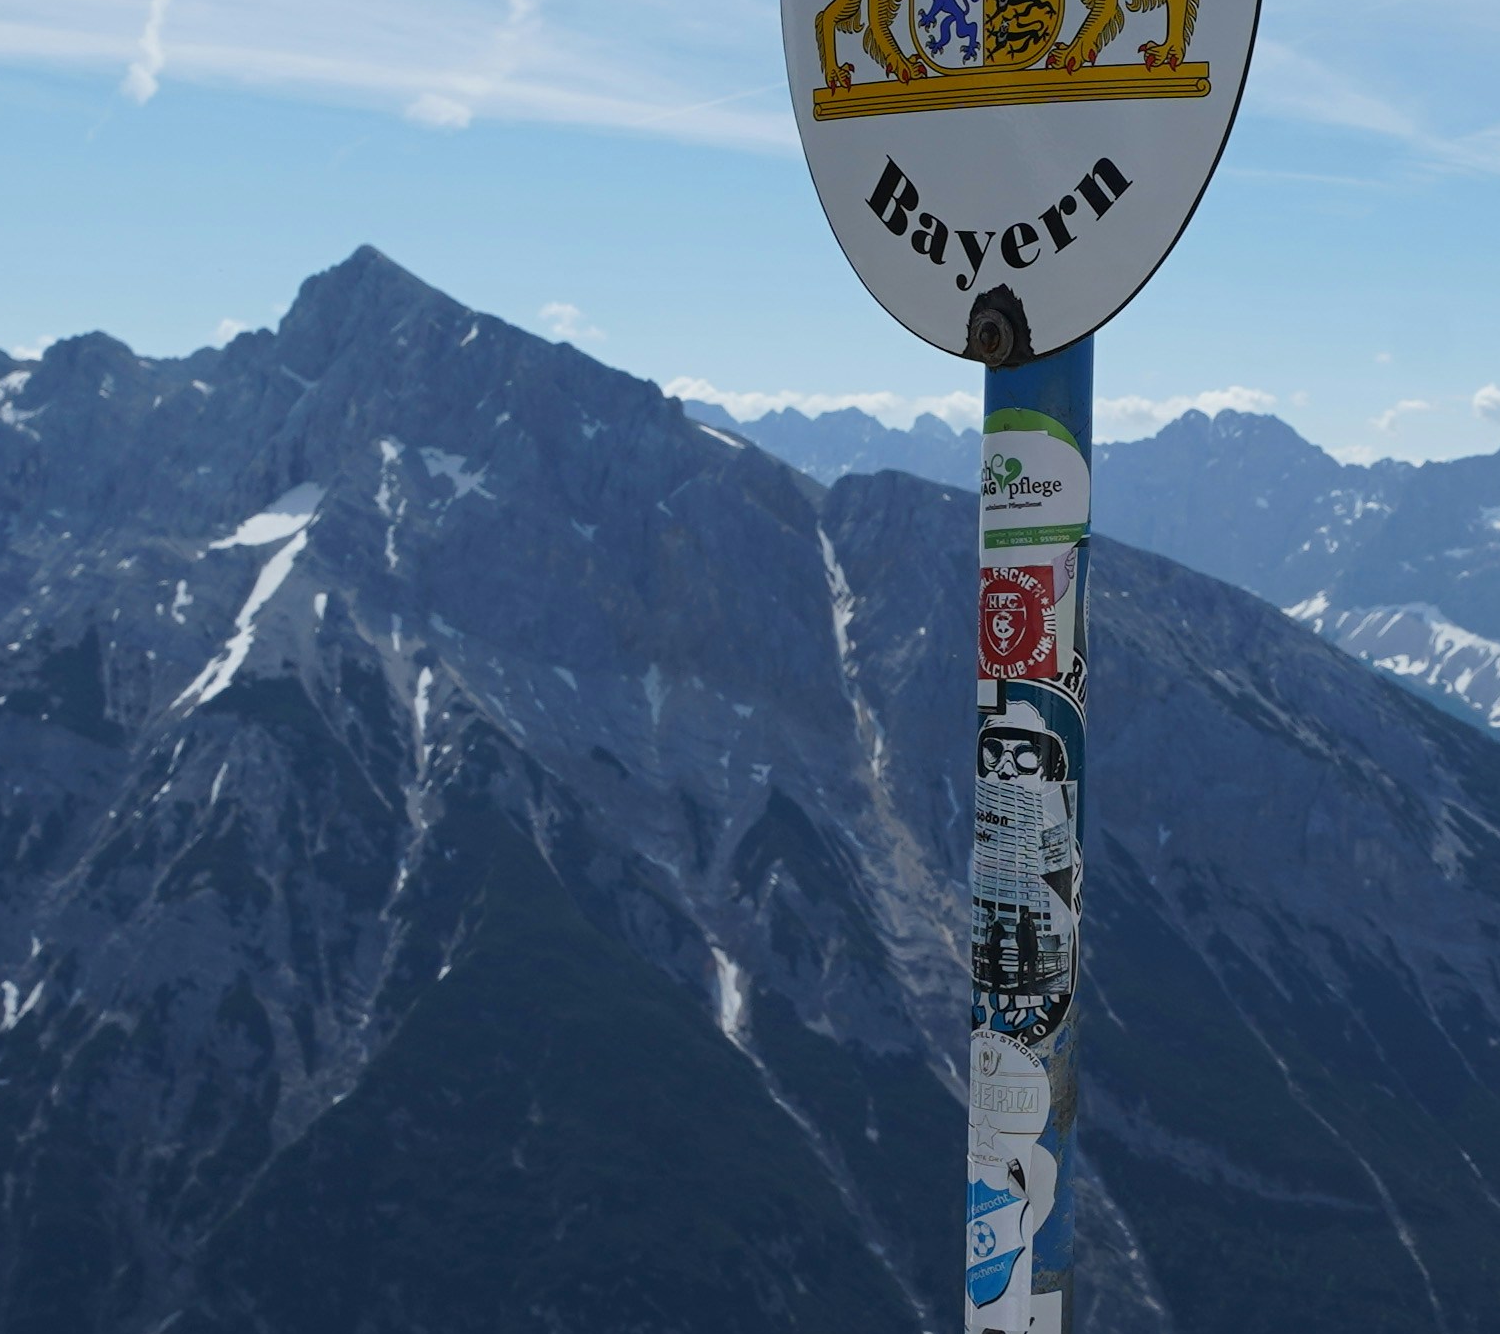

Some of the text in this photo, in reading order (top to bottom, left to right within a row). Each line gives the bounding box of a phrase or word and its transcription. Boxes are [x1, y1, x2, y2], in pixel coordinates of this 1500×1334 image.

[865, 154, 1133, 292] Bayern
[1008, 476, 1063, 499] pflege
[999, 1035, 1041, 1068] STRONG
